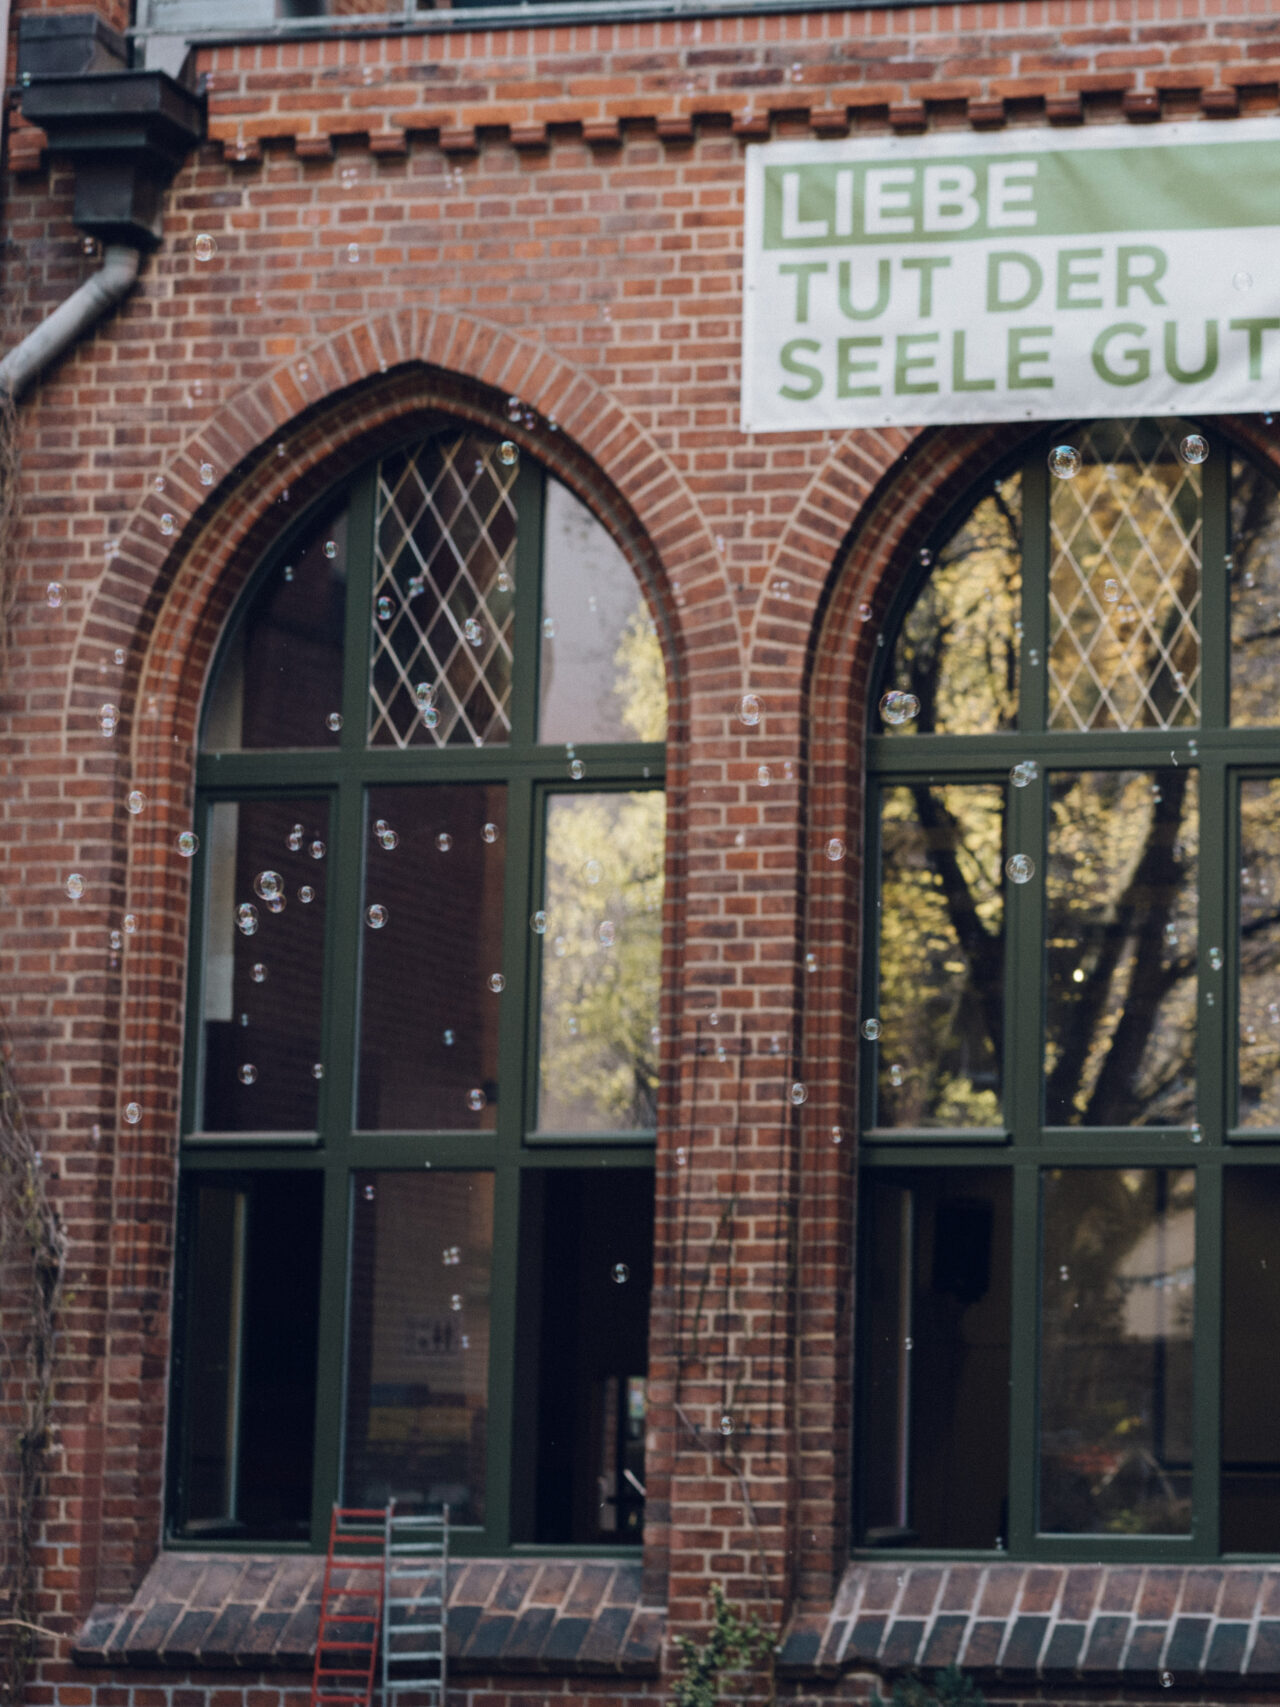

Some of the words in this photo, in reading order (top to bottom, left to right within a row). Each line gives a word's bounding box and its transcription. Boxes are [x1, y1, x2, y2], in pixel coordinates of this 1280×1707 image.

[781, 160, 1039, 239] LIEBE
[778, 257, 951, 323] TUT
[986, 245, 1167, 313] DER
[778, 326, 1055, 401] SEELE
